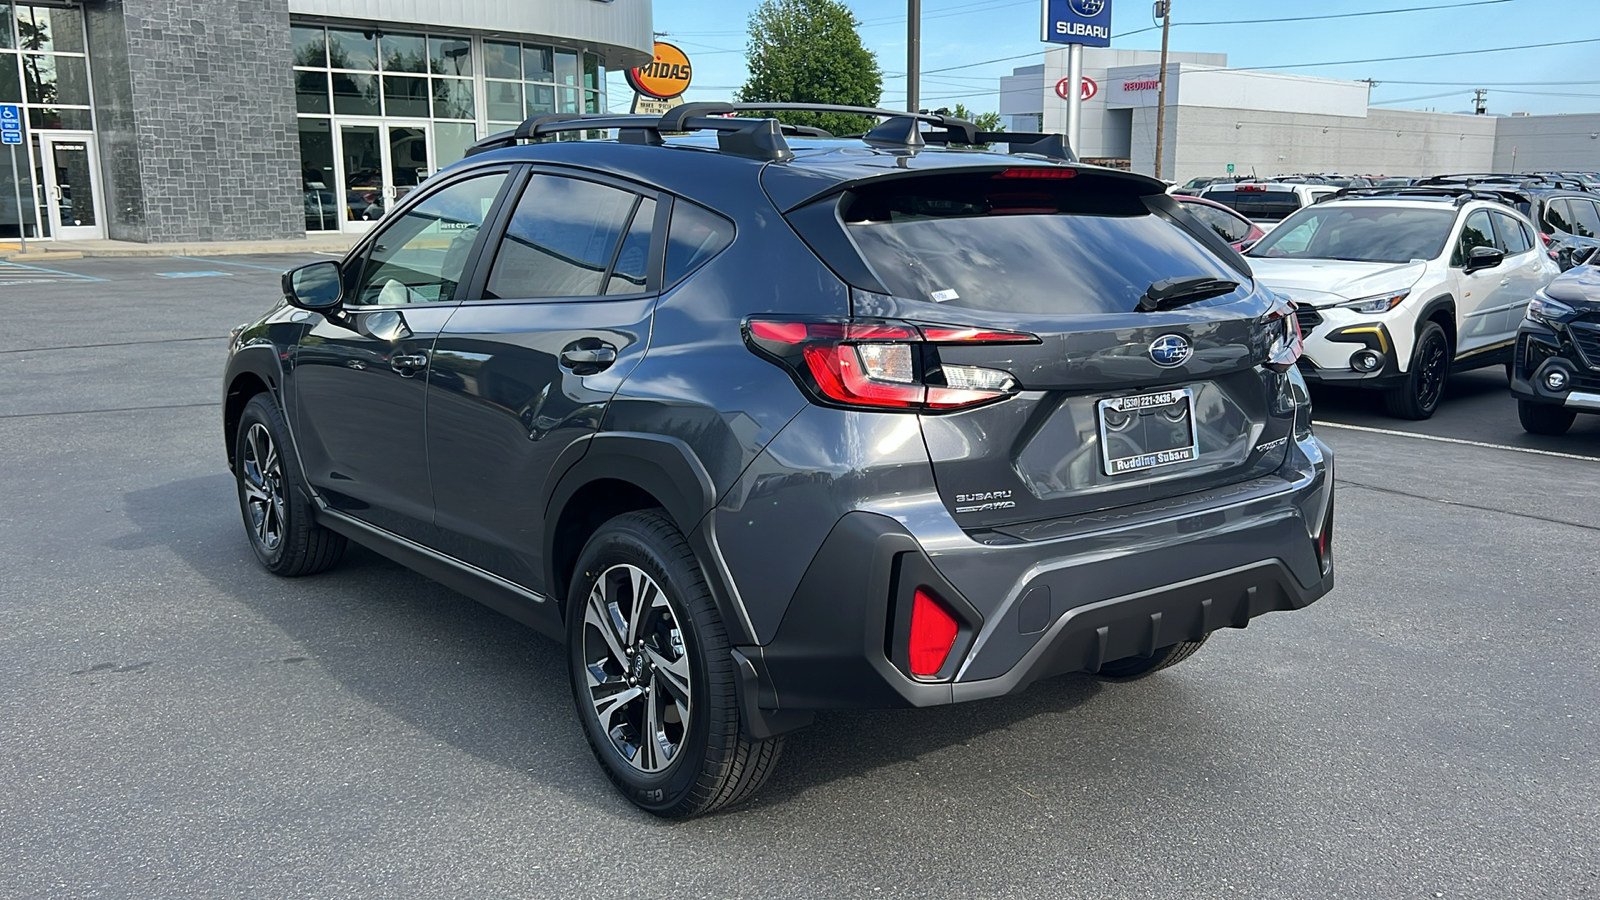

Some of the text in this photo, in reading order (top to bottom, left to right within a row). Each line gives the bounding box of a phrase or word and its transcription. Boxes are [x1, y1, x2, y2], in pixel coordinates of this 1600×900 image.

[1056, 21, 1108, 39] SUBARU
[639, 62, 690, 80] MIDAS
[1124, 394, 1170, 409] (530) 221-2436
[1117, 449, 1190, 471] Redding Subaru
[955, 490, 1012, 502] SUBARU
